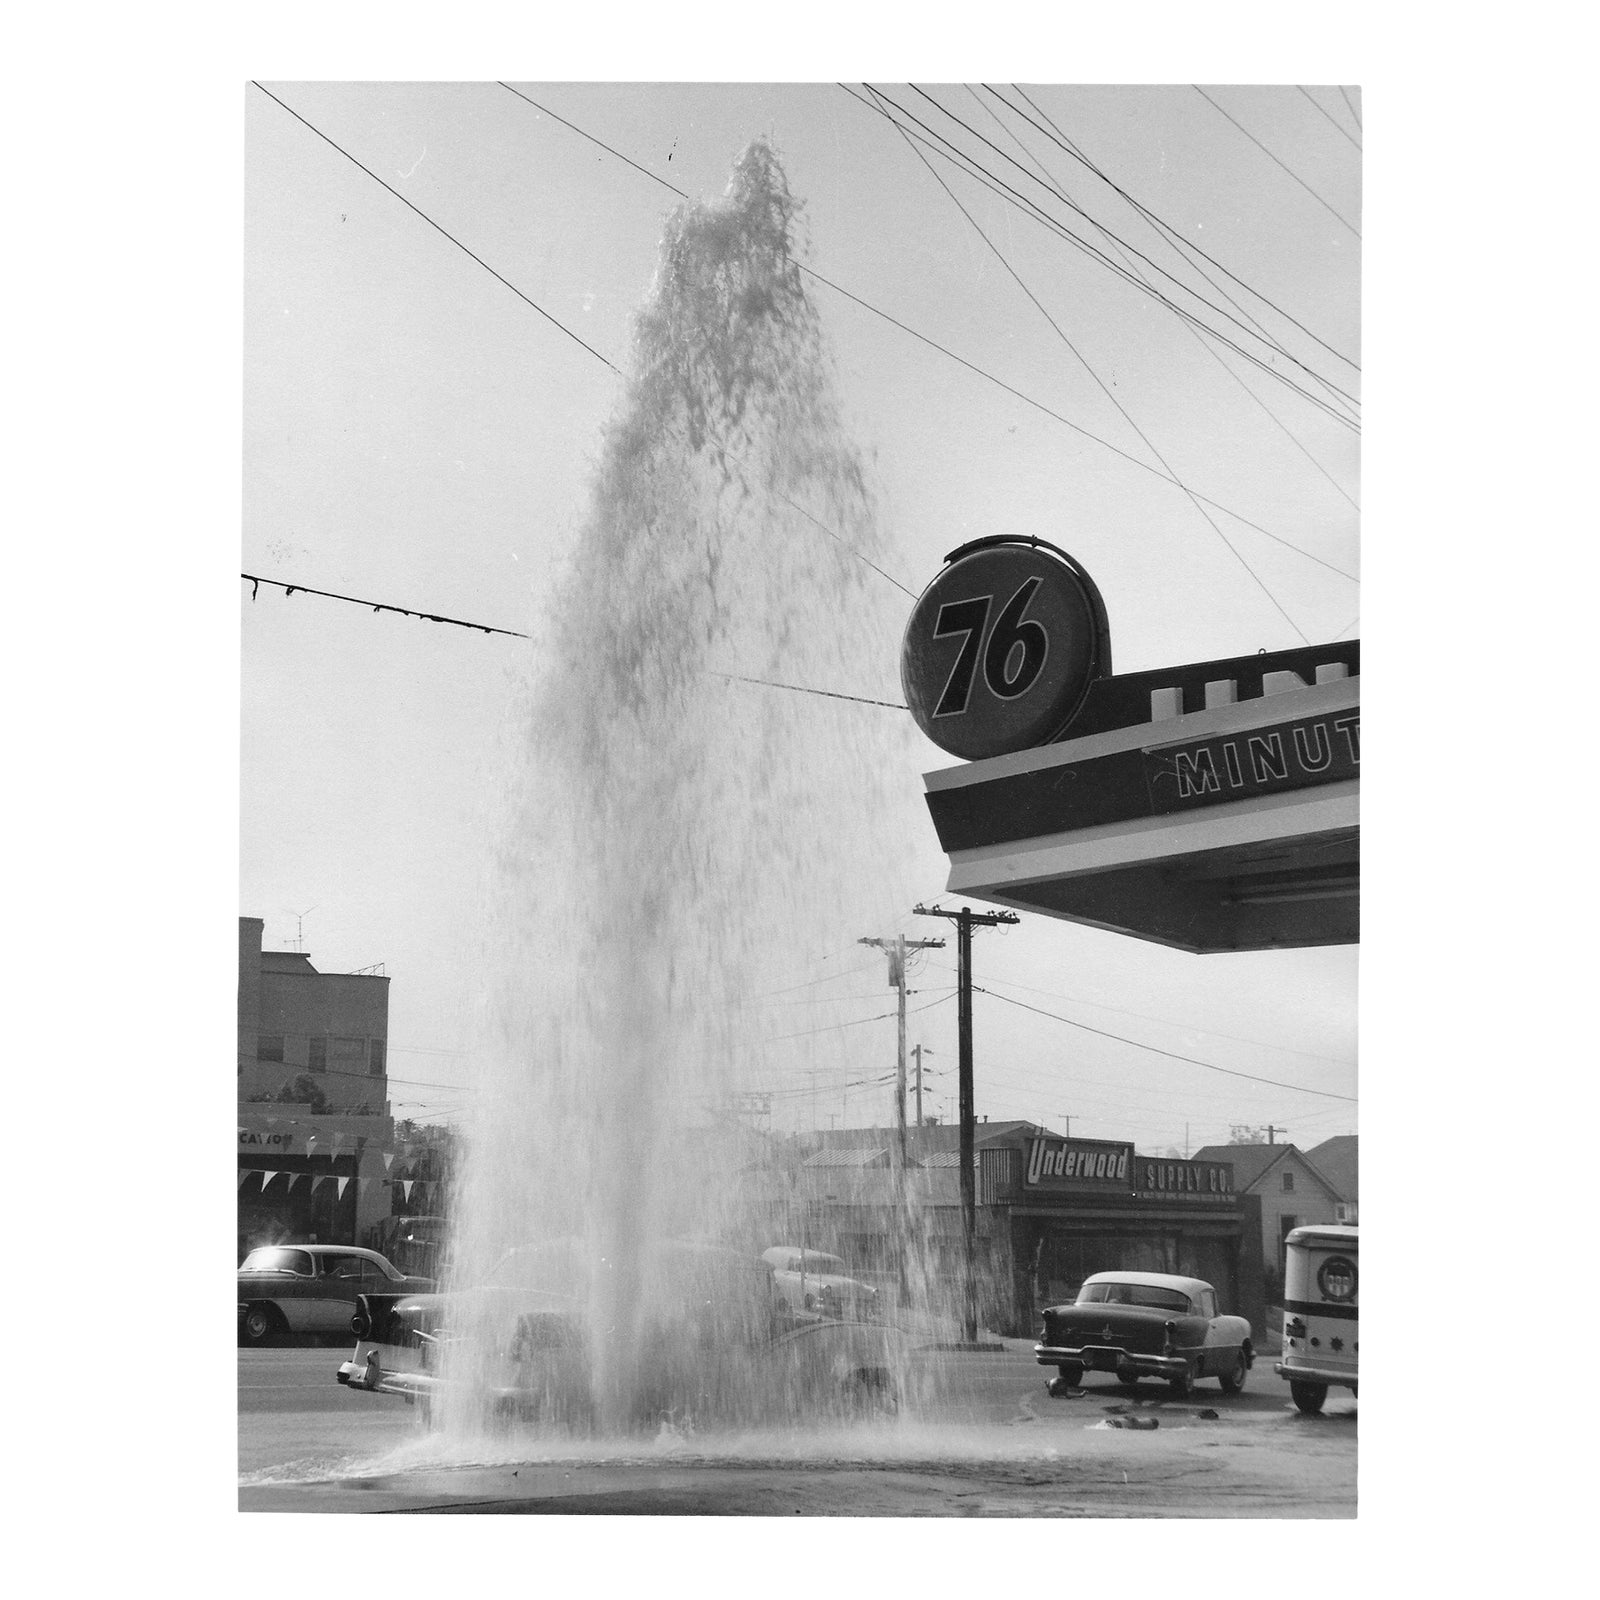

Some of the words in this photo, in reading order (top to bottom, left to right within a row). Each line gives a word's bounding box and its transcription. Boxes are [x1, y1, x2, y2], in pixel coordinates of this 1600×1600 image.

[932, 576, 1049, 718] 76
[1175, 716, 1360, 798] MINUT
[1027, 1127, 1129, 1184] Underwood
[1147, 1164, 1201, 1191] SUPPLY
[1210, 1168, 1231, 1193] CO.
